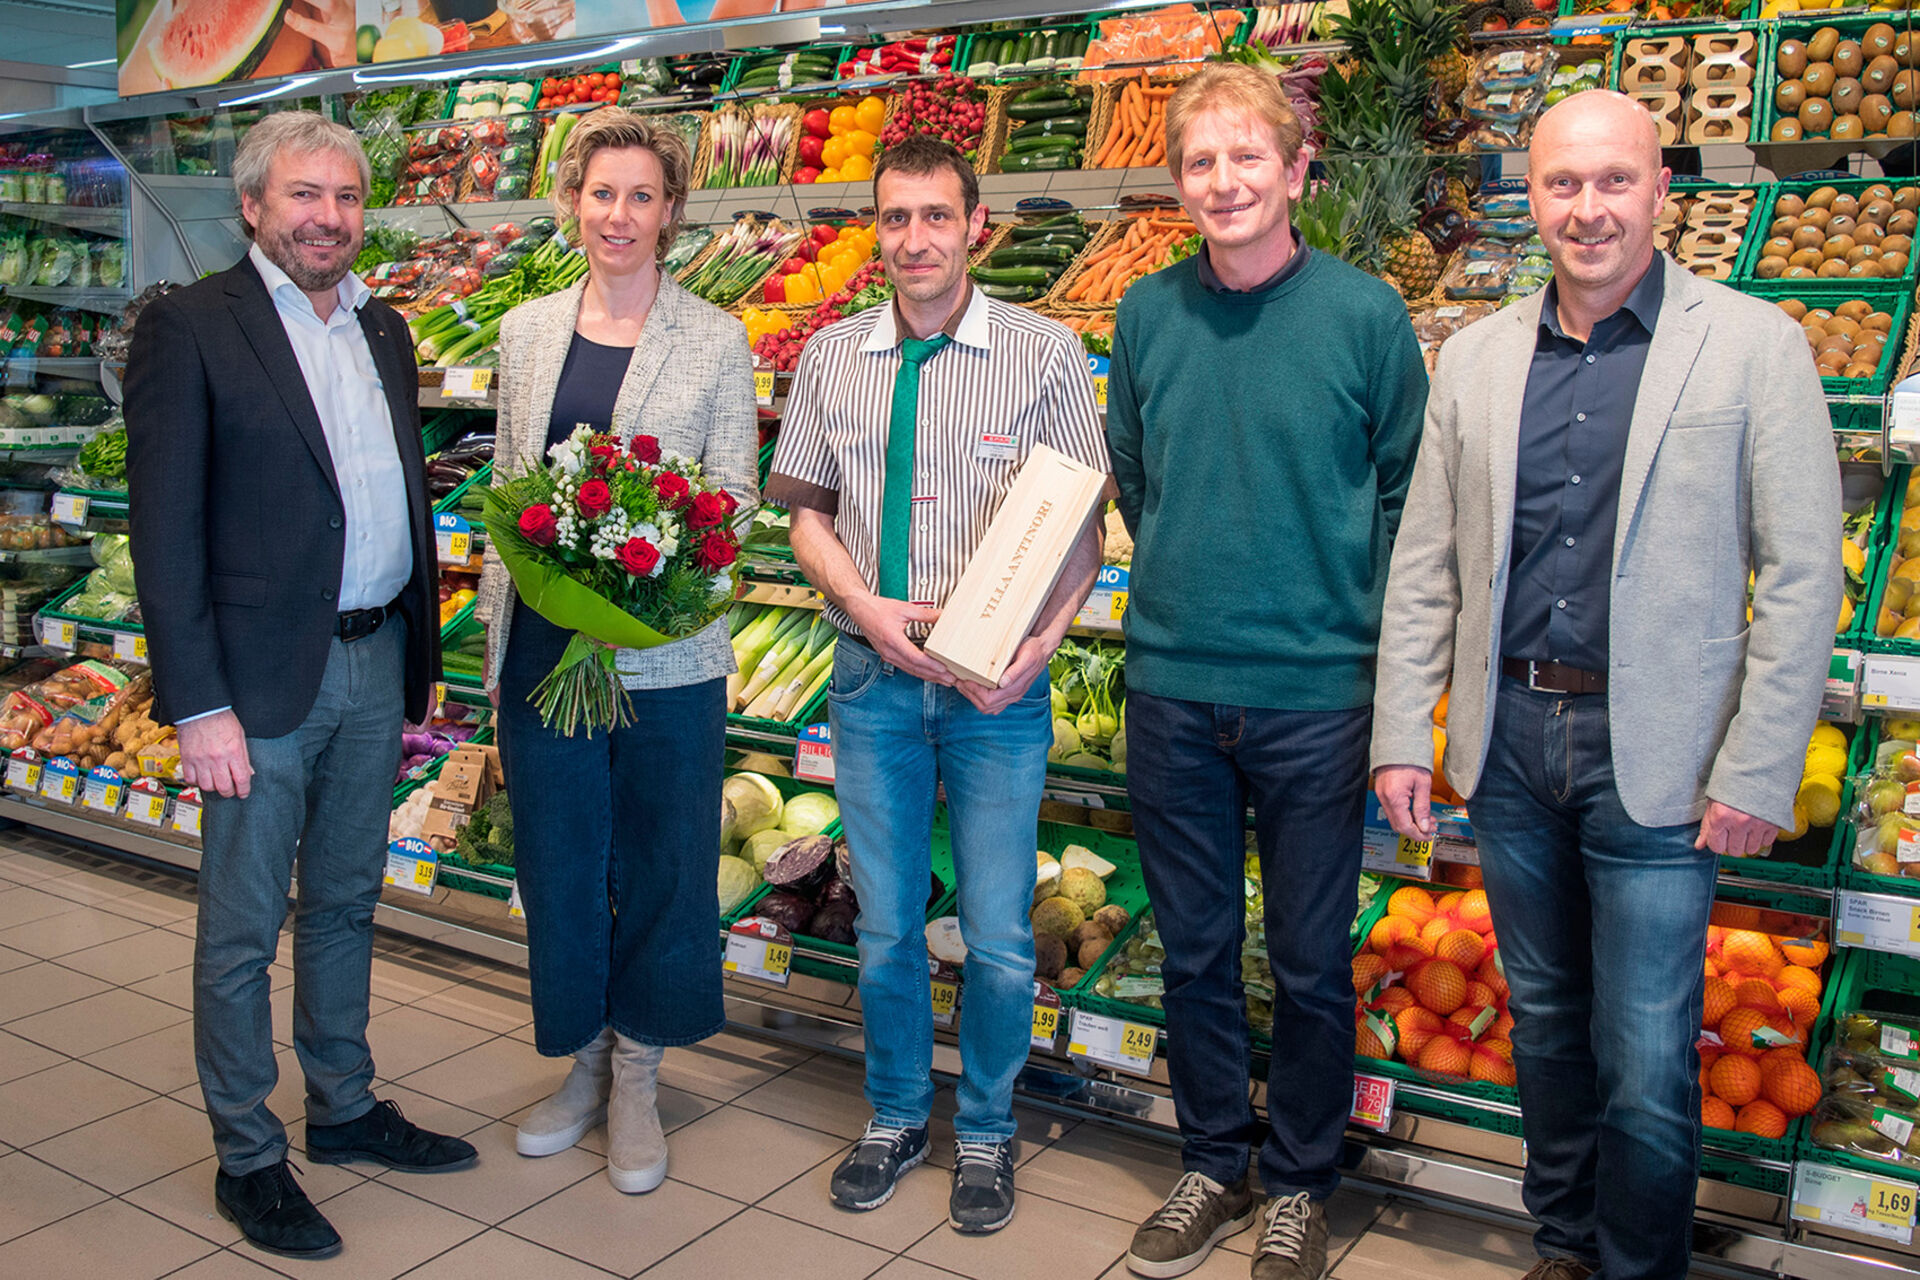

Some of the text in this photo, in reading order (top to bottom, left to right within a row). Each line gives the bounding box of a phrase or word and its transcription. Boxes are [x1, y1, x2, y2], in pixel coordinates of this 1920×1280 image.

[439, 515, 457, 528] BIO
[980, 499, 1053, 618] VILLA ANTINORI
[1097, 569, 1120, 584] IO
[819, 725, 831, 739] BI
[57, 758, 70, 770] BIO
[99, 767, 113, 780] BIO
[405, 839, 424, 854] BIO
[1403, 838, 1429, 855] 2,99
[1849, 898, 1867, 906] SPAR
[768, 948, 789, 964] 1,49
[932, 987, 953, 1004] 1,99
[1032, 1010, 1055, 1027] 1,99
[1126, 1029, 1152, 1048] 2,49
[1805, 1169, 1841, 1182] S-BUDGET
[1877, 1190, 1911, 1213] 1,69
